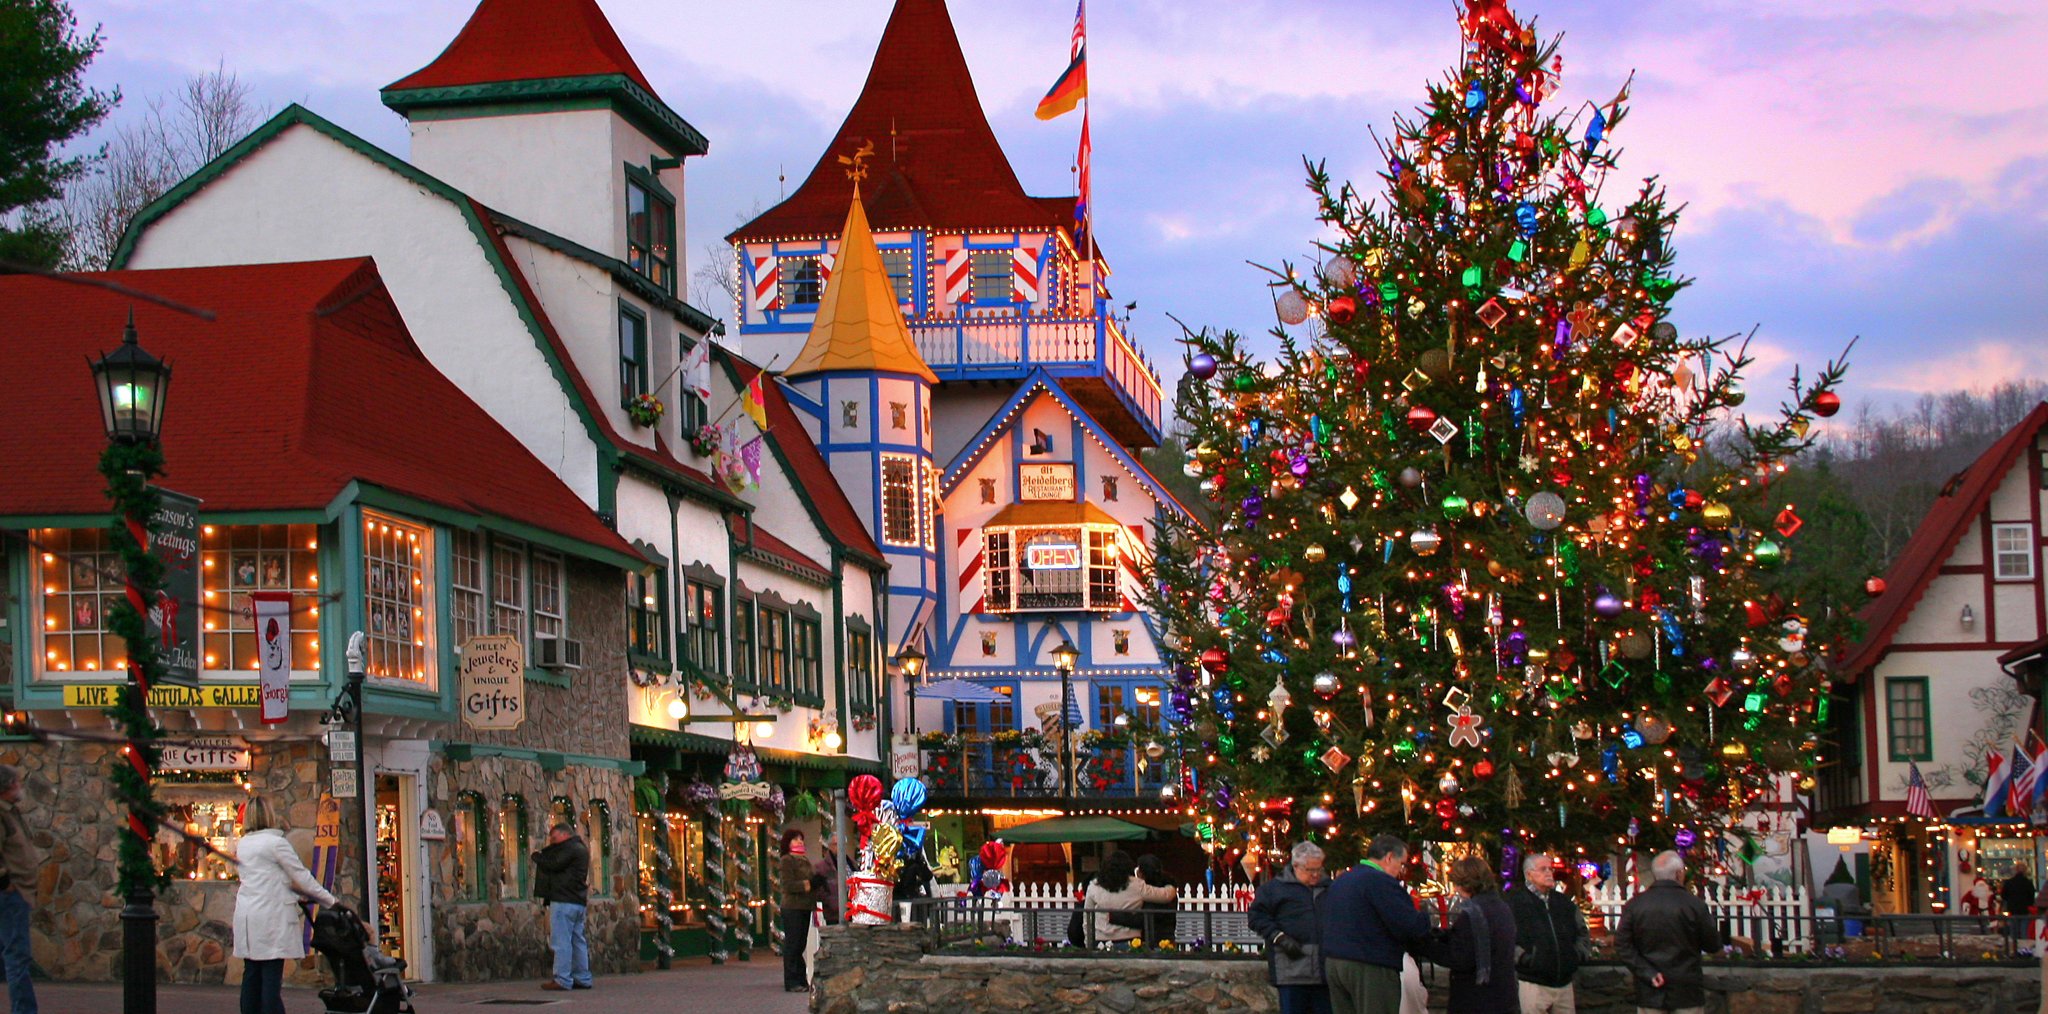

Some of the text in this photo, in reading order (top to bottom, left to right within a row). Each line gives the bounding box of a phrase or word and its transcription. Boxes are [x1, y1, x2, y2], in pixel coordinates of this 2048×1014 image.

[1022, 475, 1074, 489] Heidelberg
[1028, 485, 1067, 493] RESTAURANT
[1037, 490, 1061, 498] LOUNGE
[154, 508, 194, 529] eason's
[147, 529, 196, 559] reetings
[1031, 548, 1078, 566] OPEN
[475, 643, 507, 651] HELEN
[464, 651, 519, 674] Jewelers
[473, 676, 510, 685] UNIQUE
[76, 686, 109, 705] LIVE
[467, 689, 519, 720] Gifts
[183, 747, 238, 765] Gifts
[901, 764, 918, 774] OPEN
